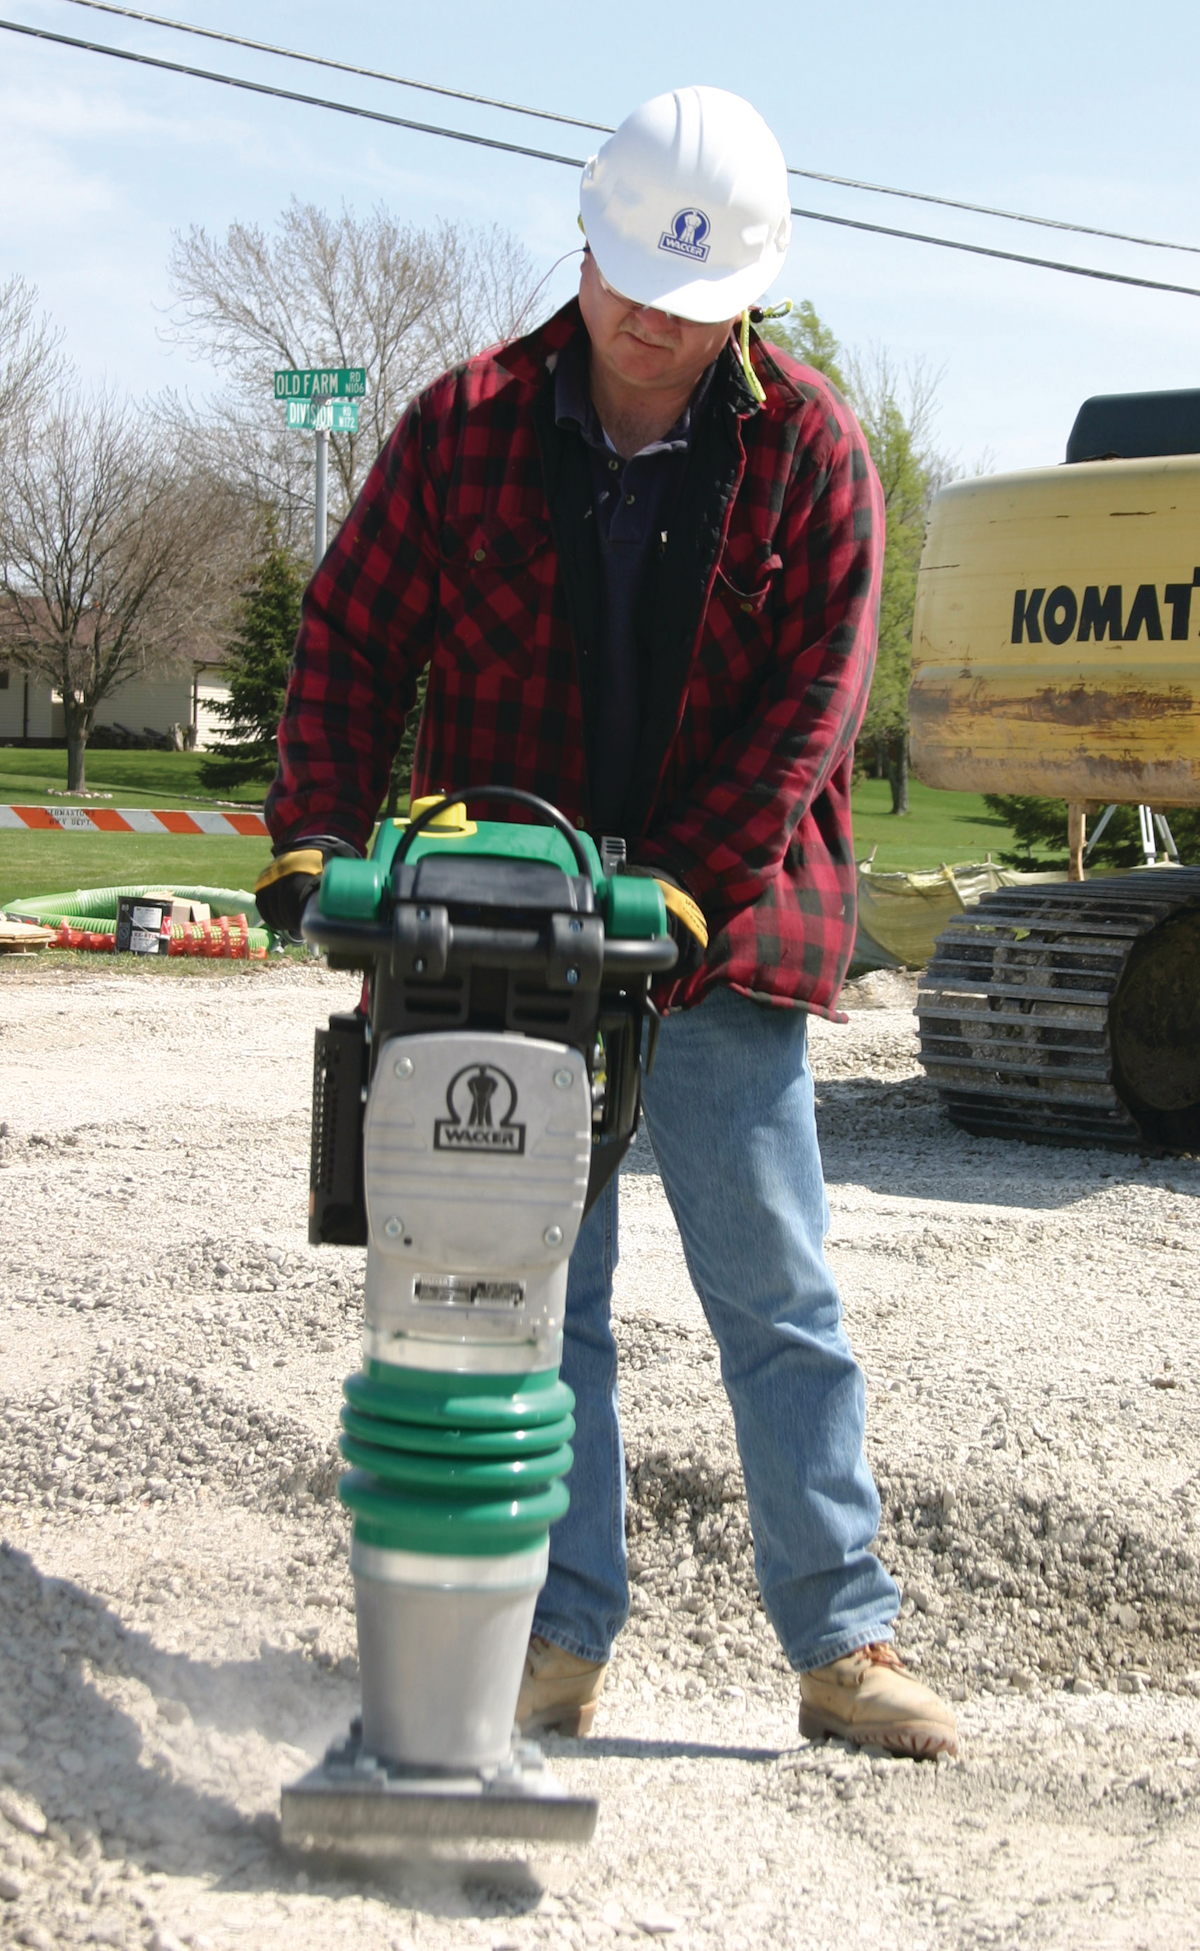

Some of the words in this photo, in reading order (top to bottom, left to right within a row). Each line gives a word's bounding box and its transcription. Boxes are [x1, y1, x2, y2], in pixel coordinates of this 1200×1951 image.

[665, 237, 704, 257] WACKER
[276, 374, 300, 396] OLD
[303, 373, 339, 395] FARM
[349, 372, 361, 382] RD
[345, 383, 365, 394] N106
[289, 401, 334, 426] DIVISION
[343, 405, 352, 416] RD
[338, 416, 355, 428] W172
[1011, 567, 1200, 645] KOMAT
[444, 1127, 515, 1147] WACKER
